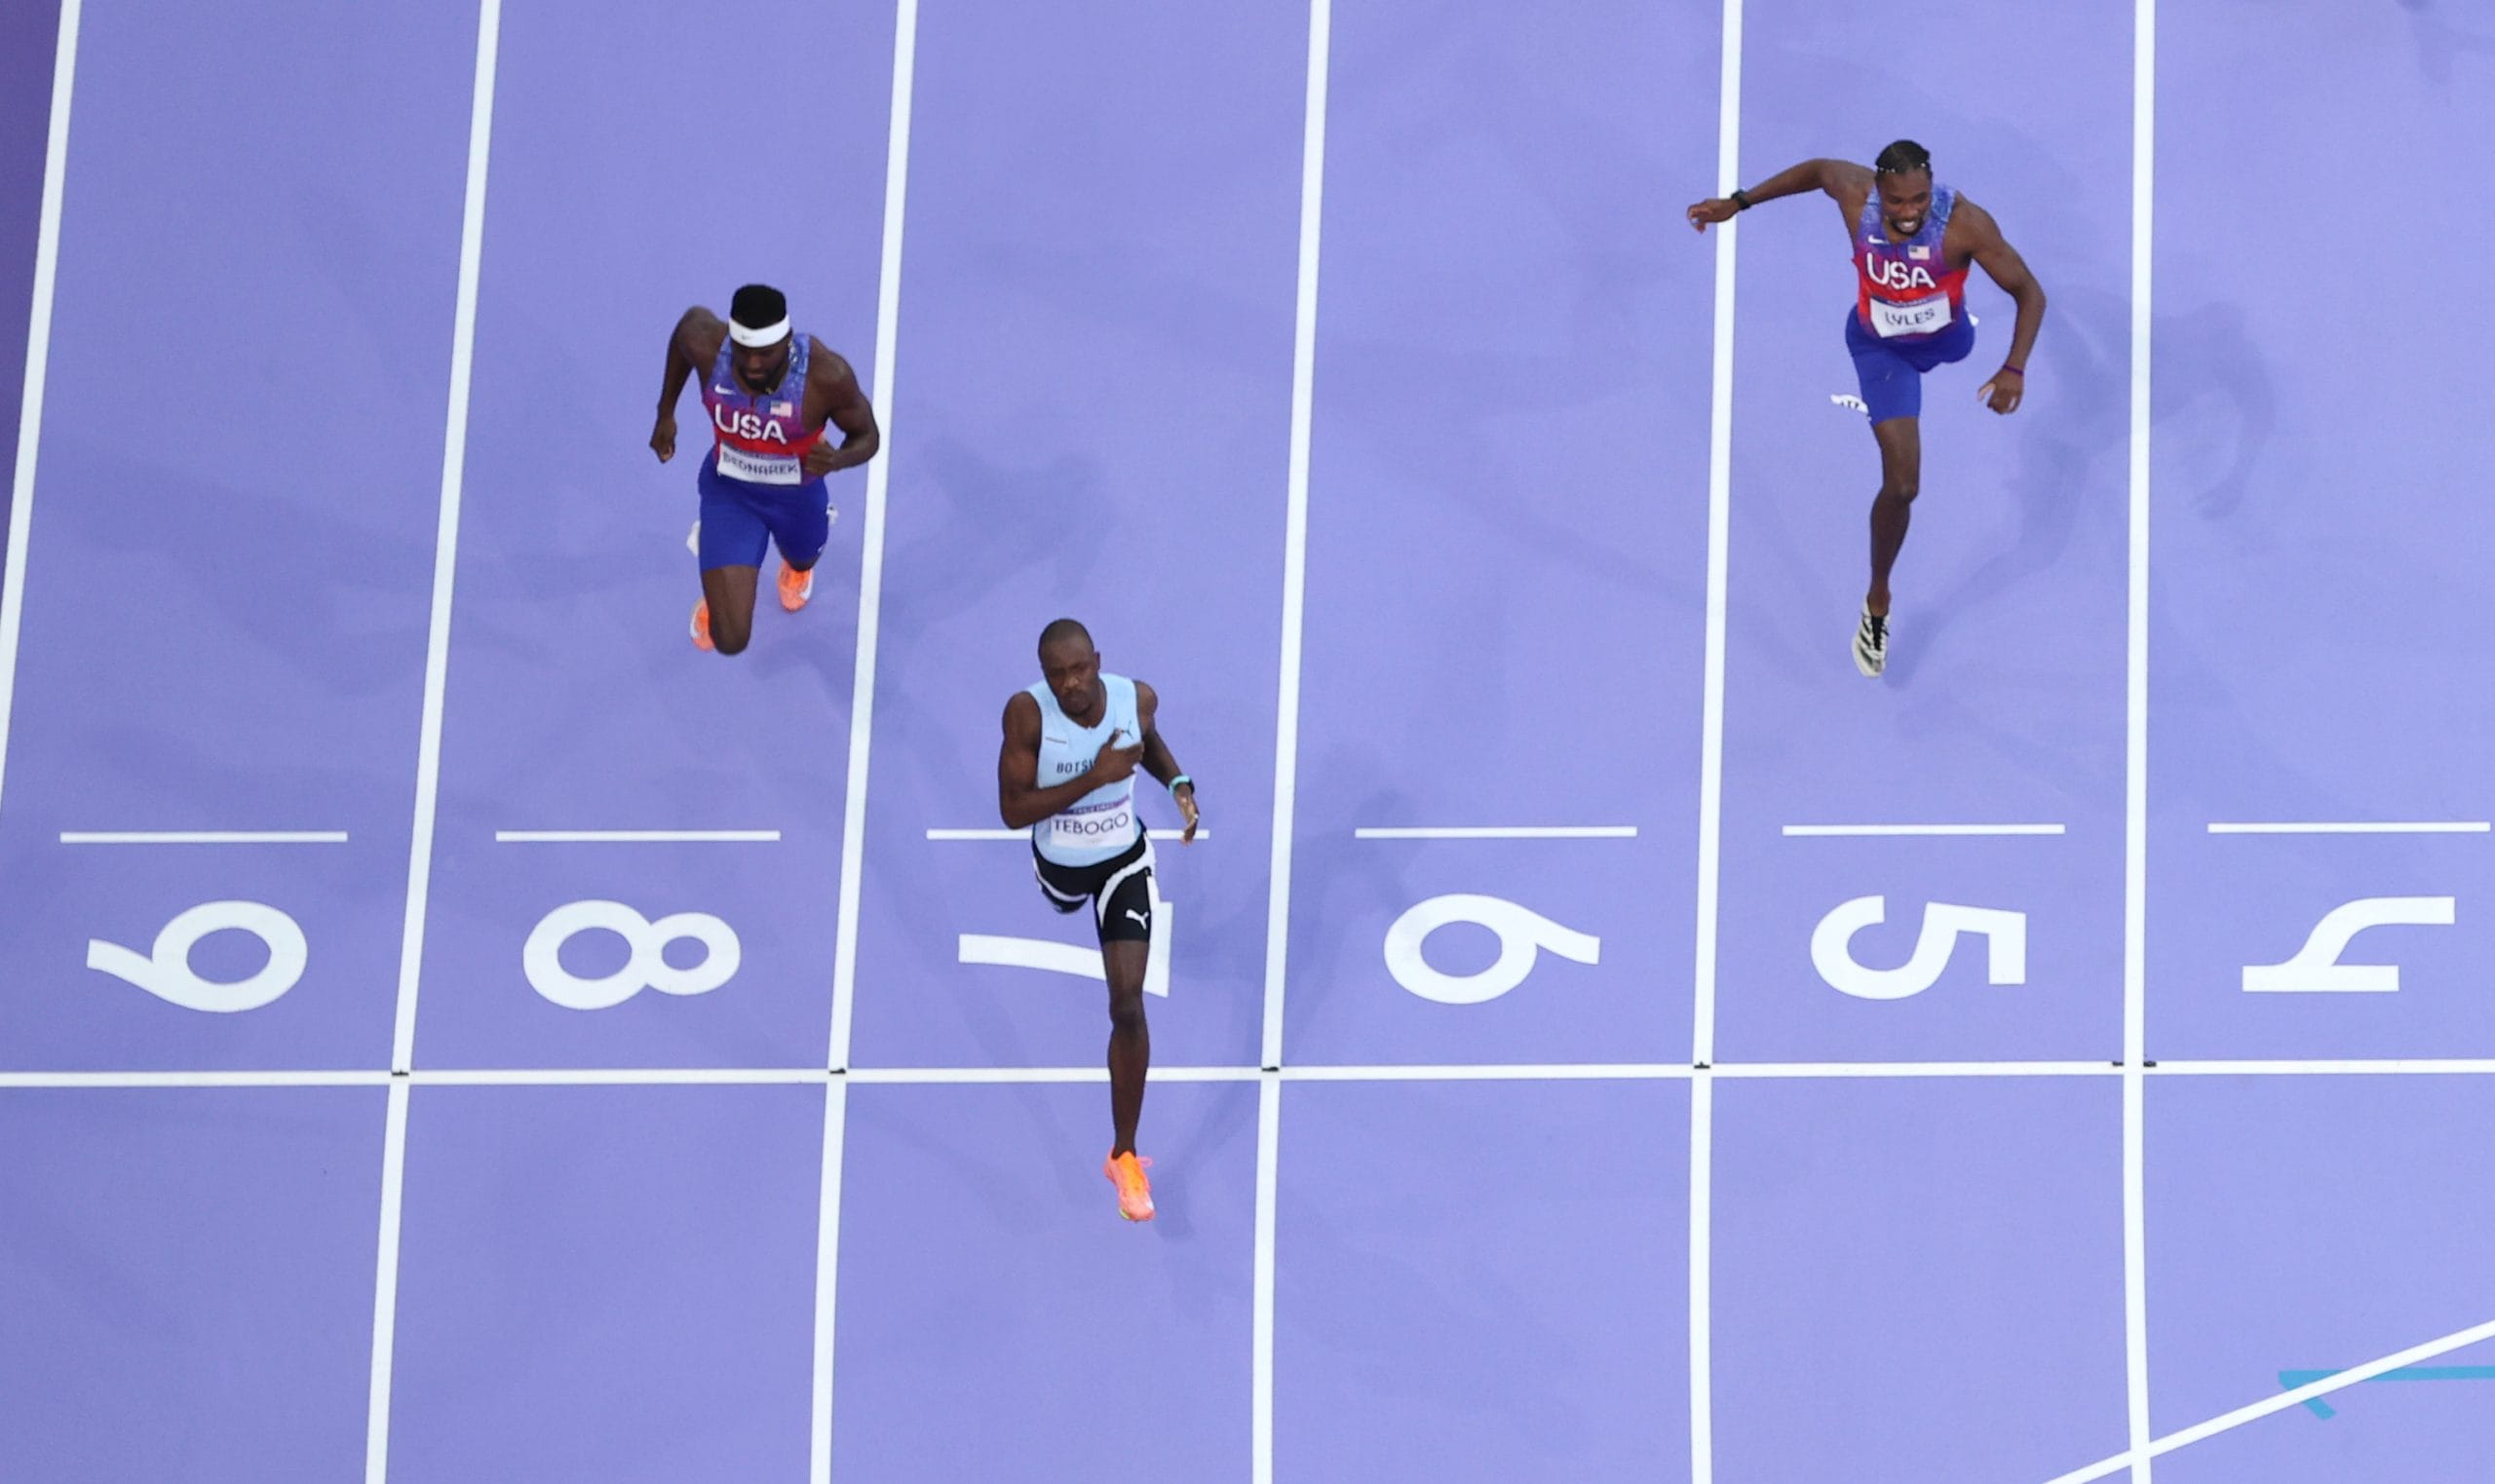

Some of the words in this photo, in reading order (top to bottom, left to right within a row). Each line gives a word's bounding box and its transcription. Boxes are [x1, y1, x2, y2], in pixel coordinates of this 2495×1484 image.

[1866, 252, 1936, 289] USA
[1884, 308, 1935, 325] LYLES
[714, 403, 787, 444] USA
[1055, 813, 1128, 835] TEBOGO
[87, 900, 307, 1012] 9
[523, 899, 741, 1009] 8
[958, 901, 1172, 998] 7
[1384, 894, 1600, 1004] 6
[1810, 894, 2026, 1000] 5
[2242, 896, 2455, 992] 4
